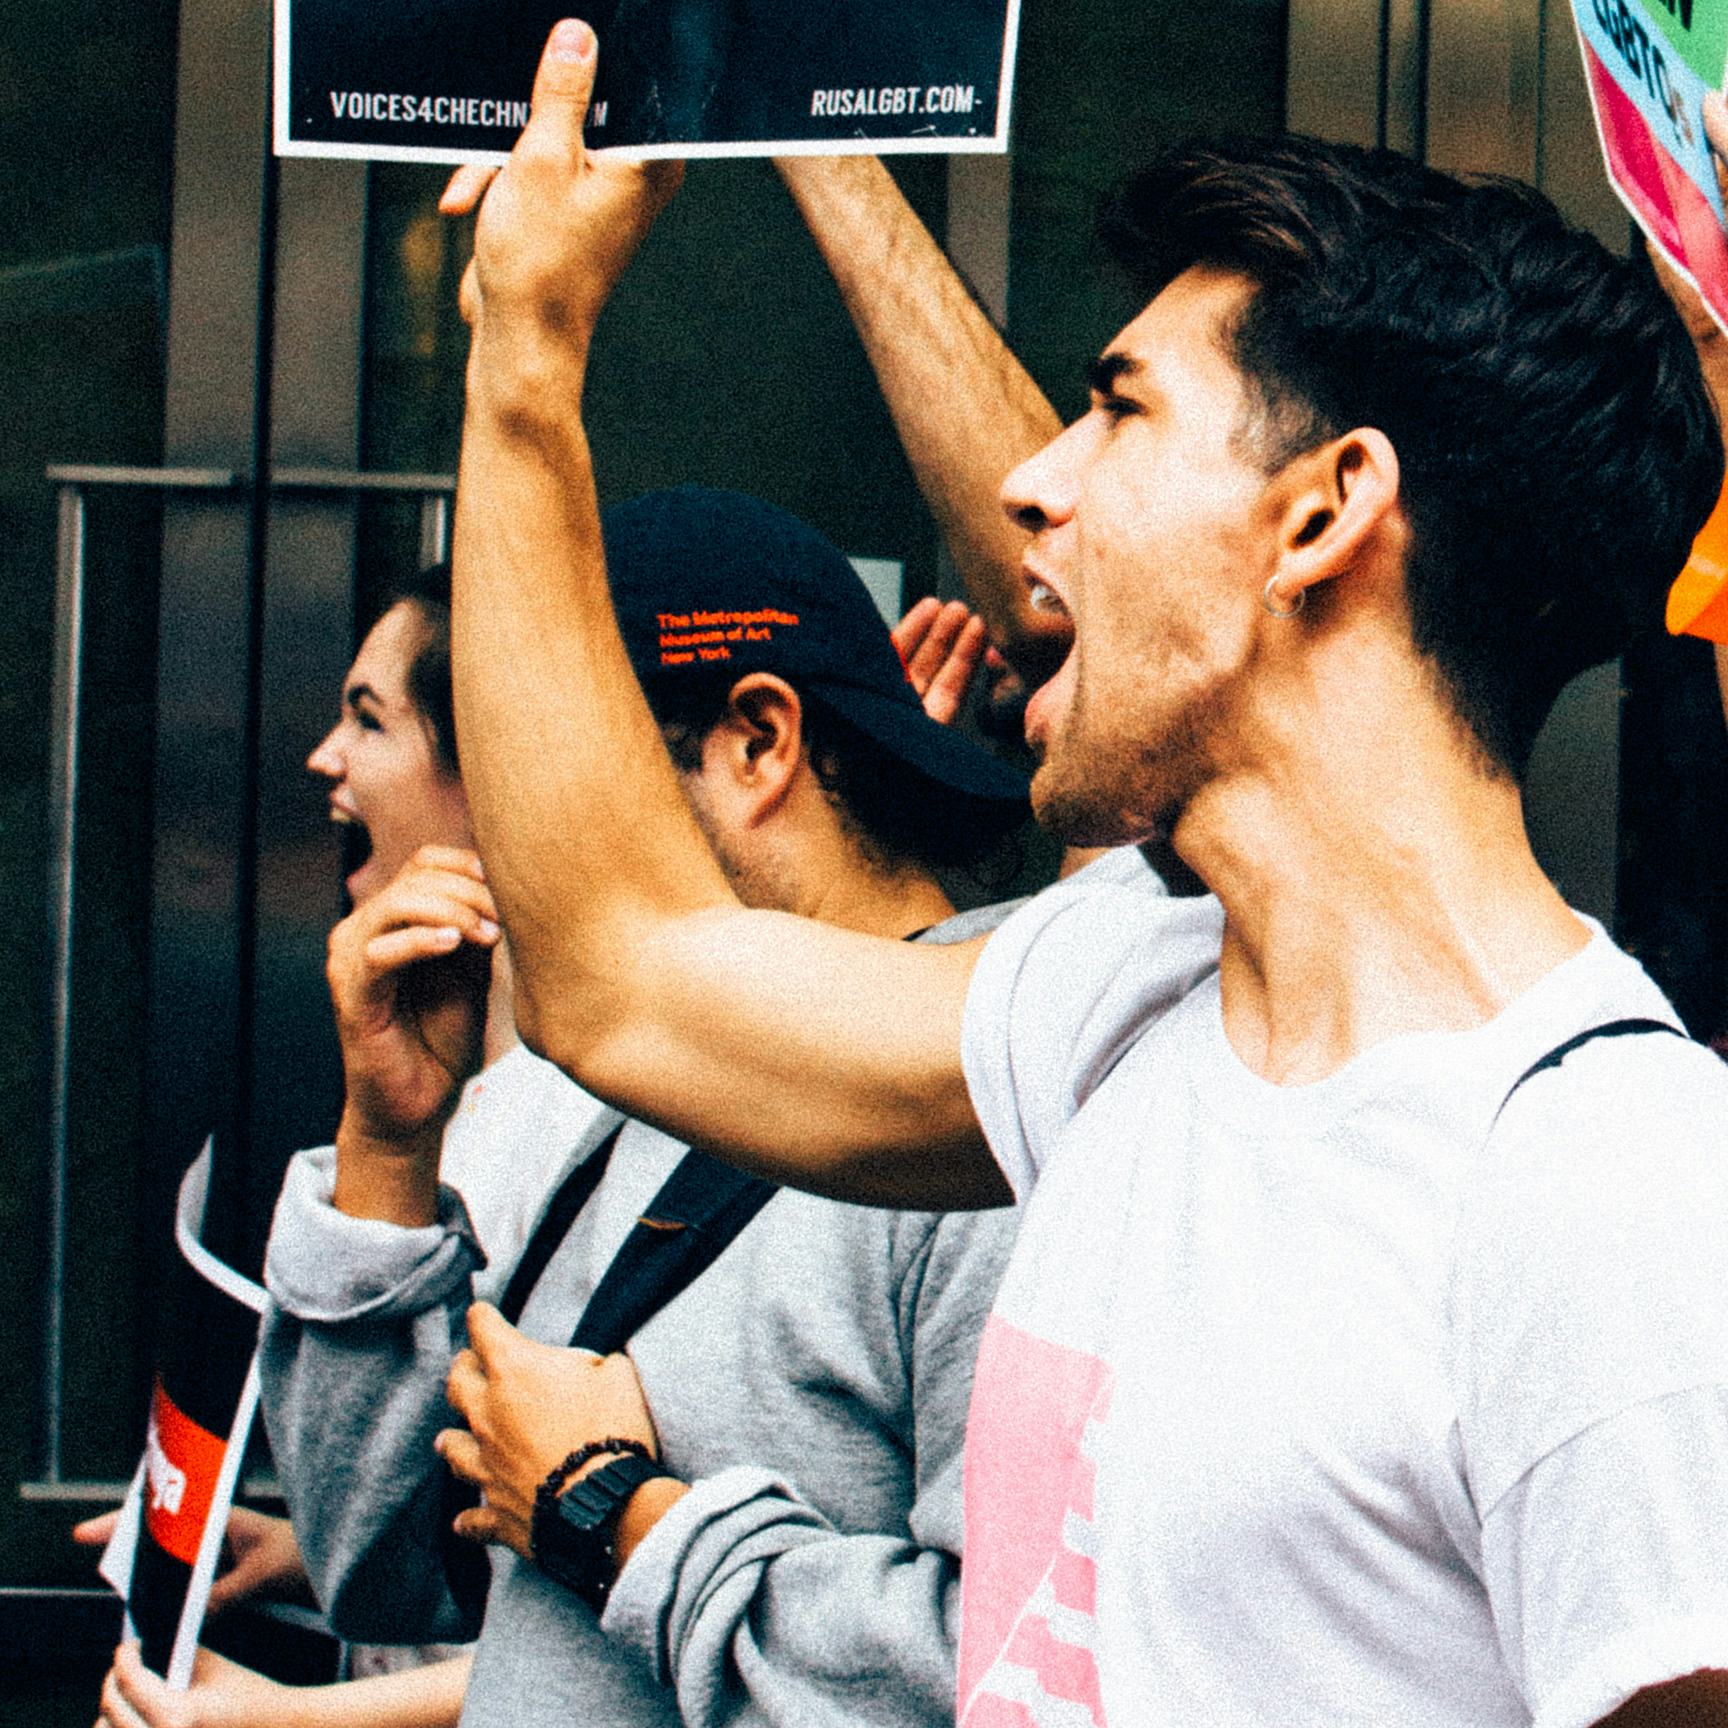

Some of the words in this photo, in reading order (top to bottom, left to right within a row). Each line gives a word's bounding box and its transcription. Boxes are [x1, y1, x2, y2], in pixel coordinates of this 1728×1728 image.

[329, 90, 608, 128] VOICES4CHECHNM
[810, 83, 975, 117] RUSALGBT.COM
[656, 612, 691, 629] The
[691, 608, 799, 627] Metropolitan
[659, 630, 724, 648] Museum
[725, 626, 743, 642] of
[745, 626, 772, 641] Art
[660, 651, 695, 666] New
[697, 645, 731, 661] York
